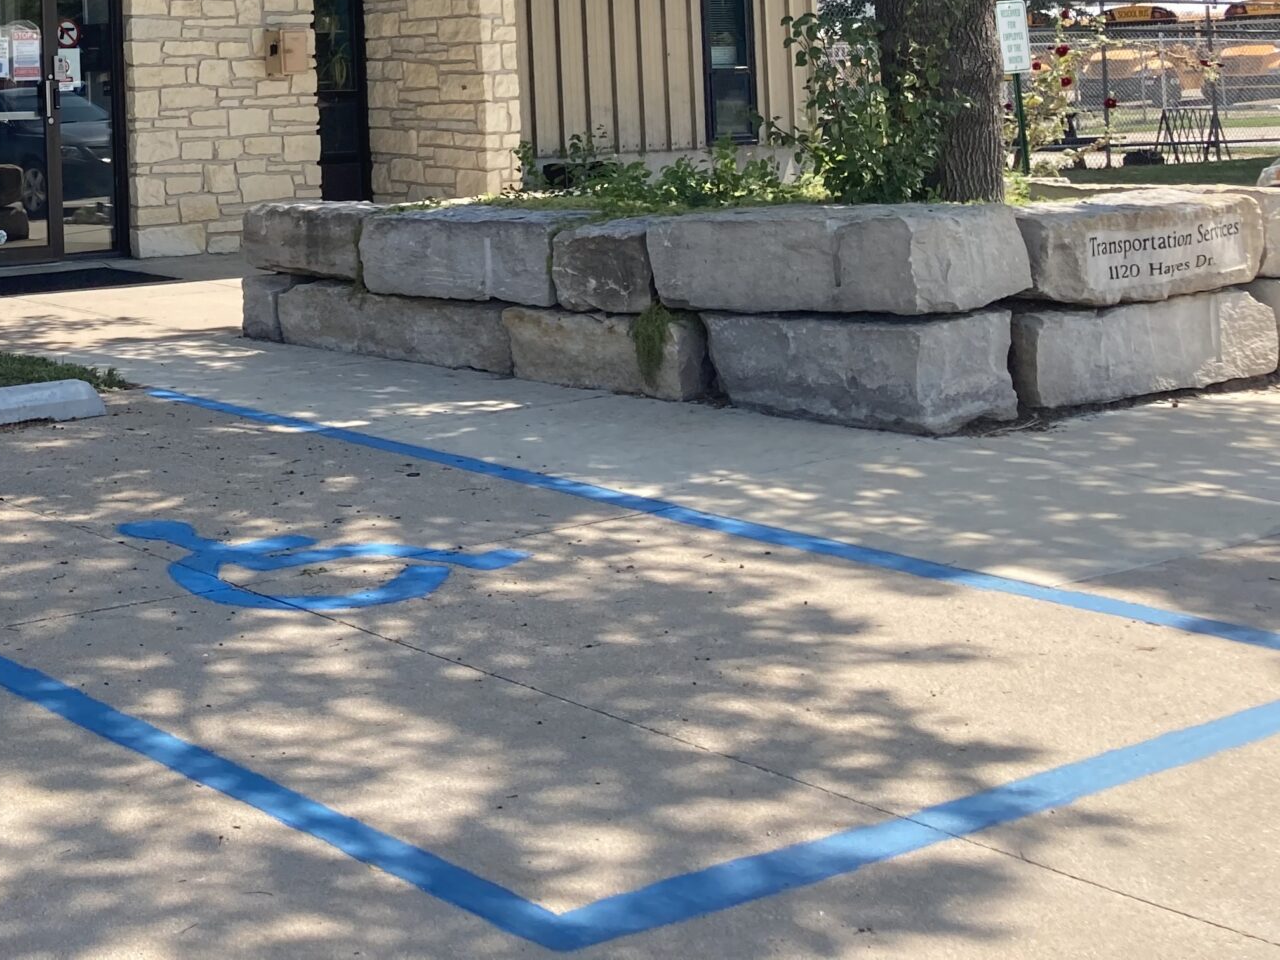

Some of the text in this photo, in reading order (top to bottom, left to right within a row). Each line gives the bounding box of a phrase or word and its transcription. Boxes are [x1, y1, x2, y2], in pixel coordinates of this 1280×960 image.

[1089, 221, 1240, 259] Transportation Services
[1109, 264, 1141, 280] 1120
[1149, 261, 1190, 278] Hayes
